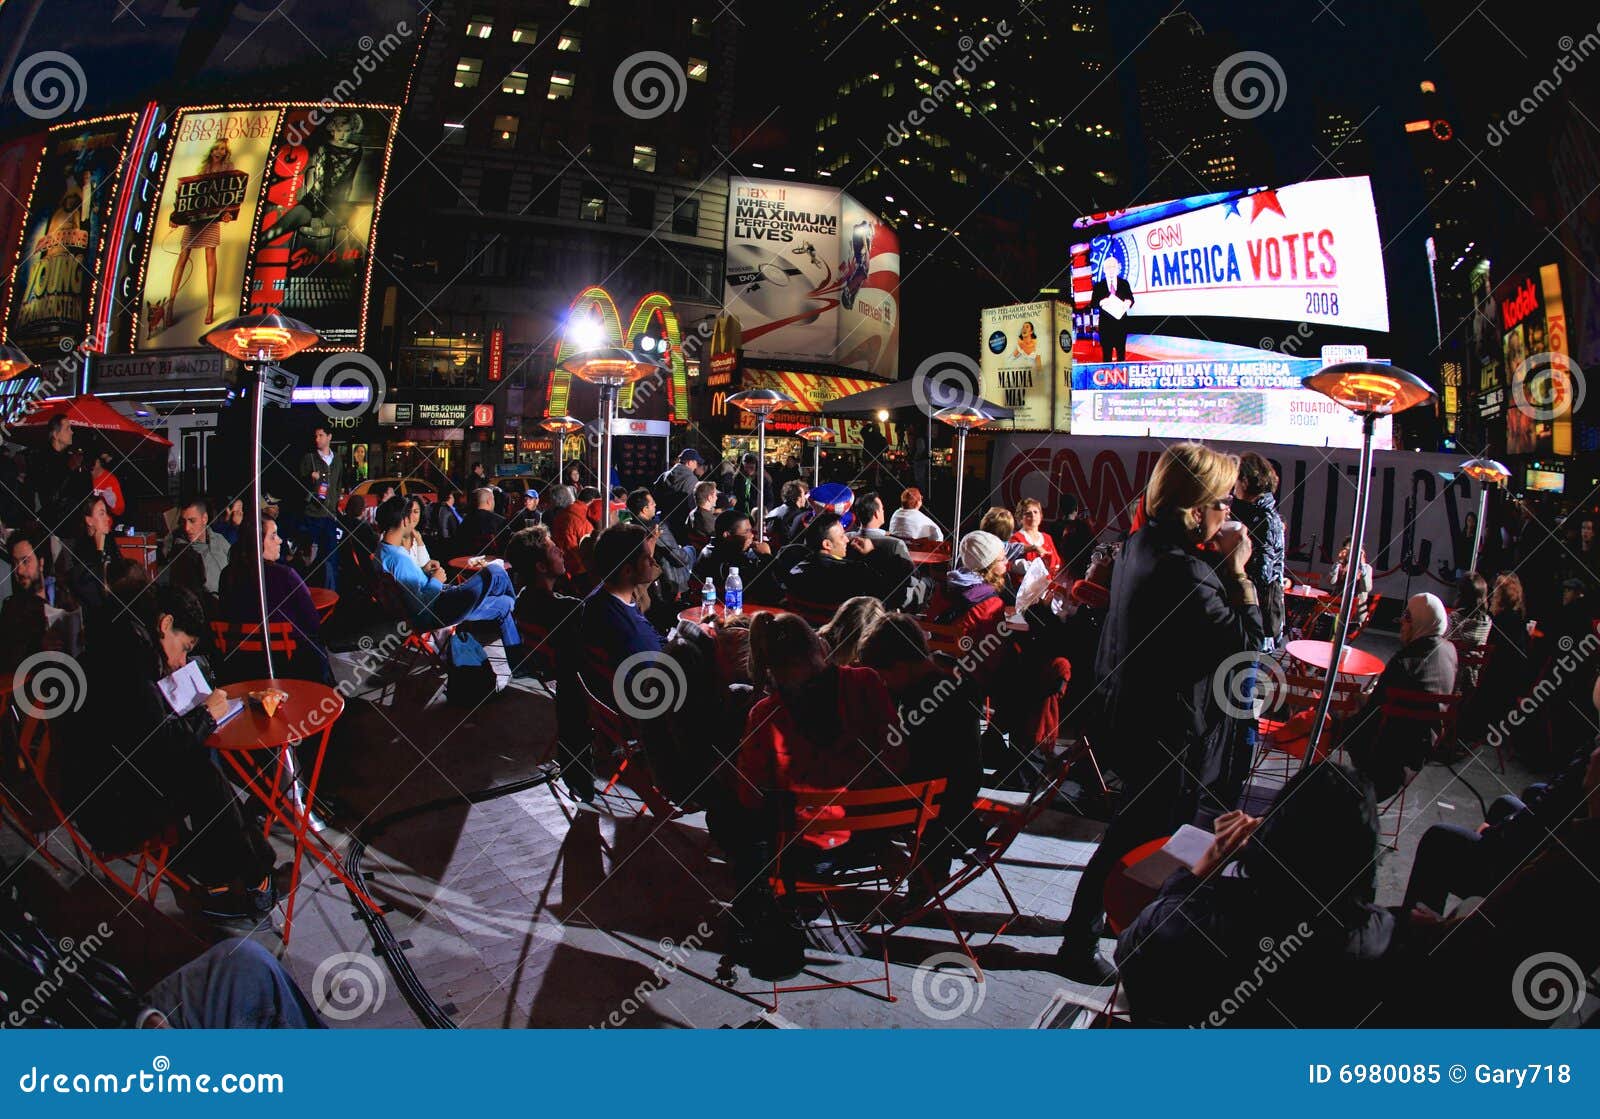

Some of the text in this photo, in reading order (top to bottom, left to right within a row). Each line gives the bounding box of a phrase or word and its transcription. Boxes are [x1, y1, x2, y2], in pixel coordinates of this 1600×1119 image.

[183, 115, 273, 133] BROADWAY
[180, 127, 272, 142] GOES BLONDE!
[180, 175, 248, 197] LEGALLY
[736, 186, 786, 201] maxll
[124, 122, 167, 297] PALACE
[178, 191, 245, 213] BLONDE
[737, 198, 785, 210] WHERE
[736, 206, 837, 227] MAXIMUM
[734, 226, 794, 243] LIVES
[735, 218, 837, 235] PERFORMANCE
[1146, 223, 1183, 250] CNN
[1151, 240, 1241, 287] AMERICA
[1247, 229, 1339, 281] VOTES
[1305, 291, 1340, 316] 2008
[1502, 277, 1539, 330] Kodak
[99, 361, 155, 378] LEGALLY
[1092, 366, 1129, 387] CNN
[1128, 362, 1290, 377] ELECTION DAY IN AMERICA
[997, 369, 1033, 389] MAMMA
[1128, 376, 1301, 388] FIRST CLUES TO THE OUTCOME
[1004, 388, 1026, 406] MIA!
[419, 404, 467, 412] TIMES SQUARE
[419, 411, 466, 419] INFORMATION
[1289, 400, 1340, 414] SITUATION
[327, 416, 364, 429] SHOP
[1289, 414, 1319, 426] ROOM
[1002, 446, 1160, 538] CNN
